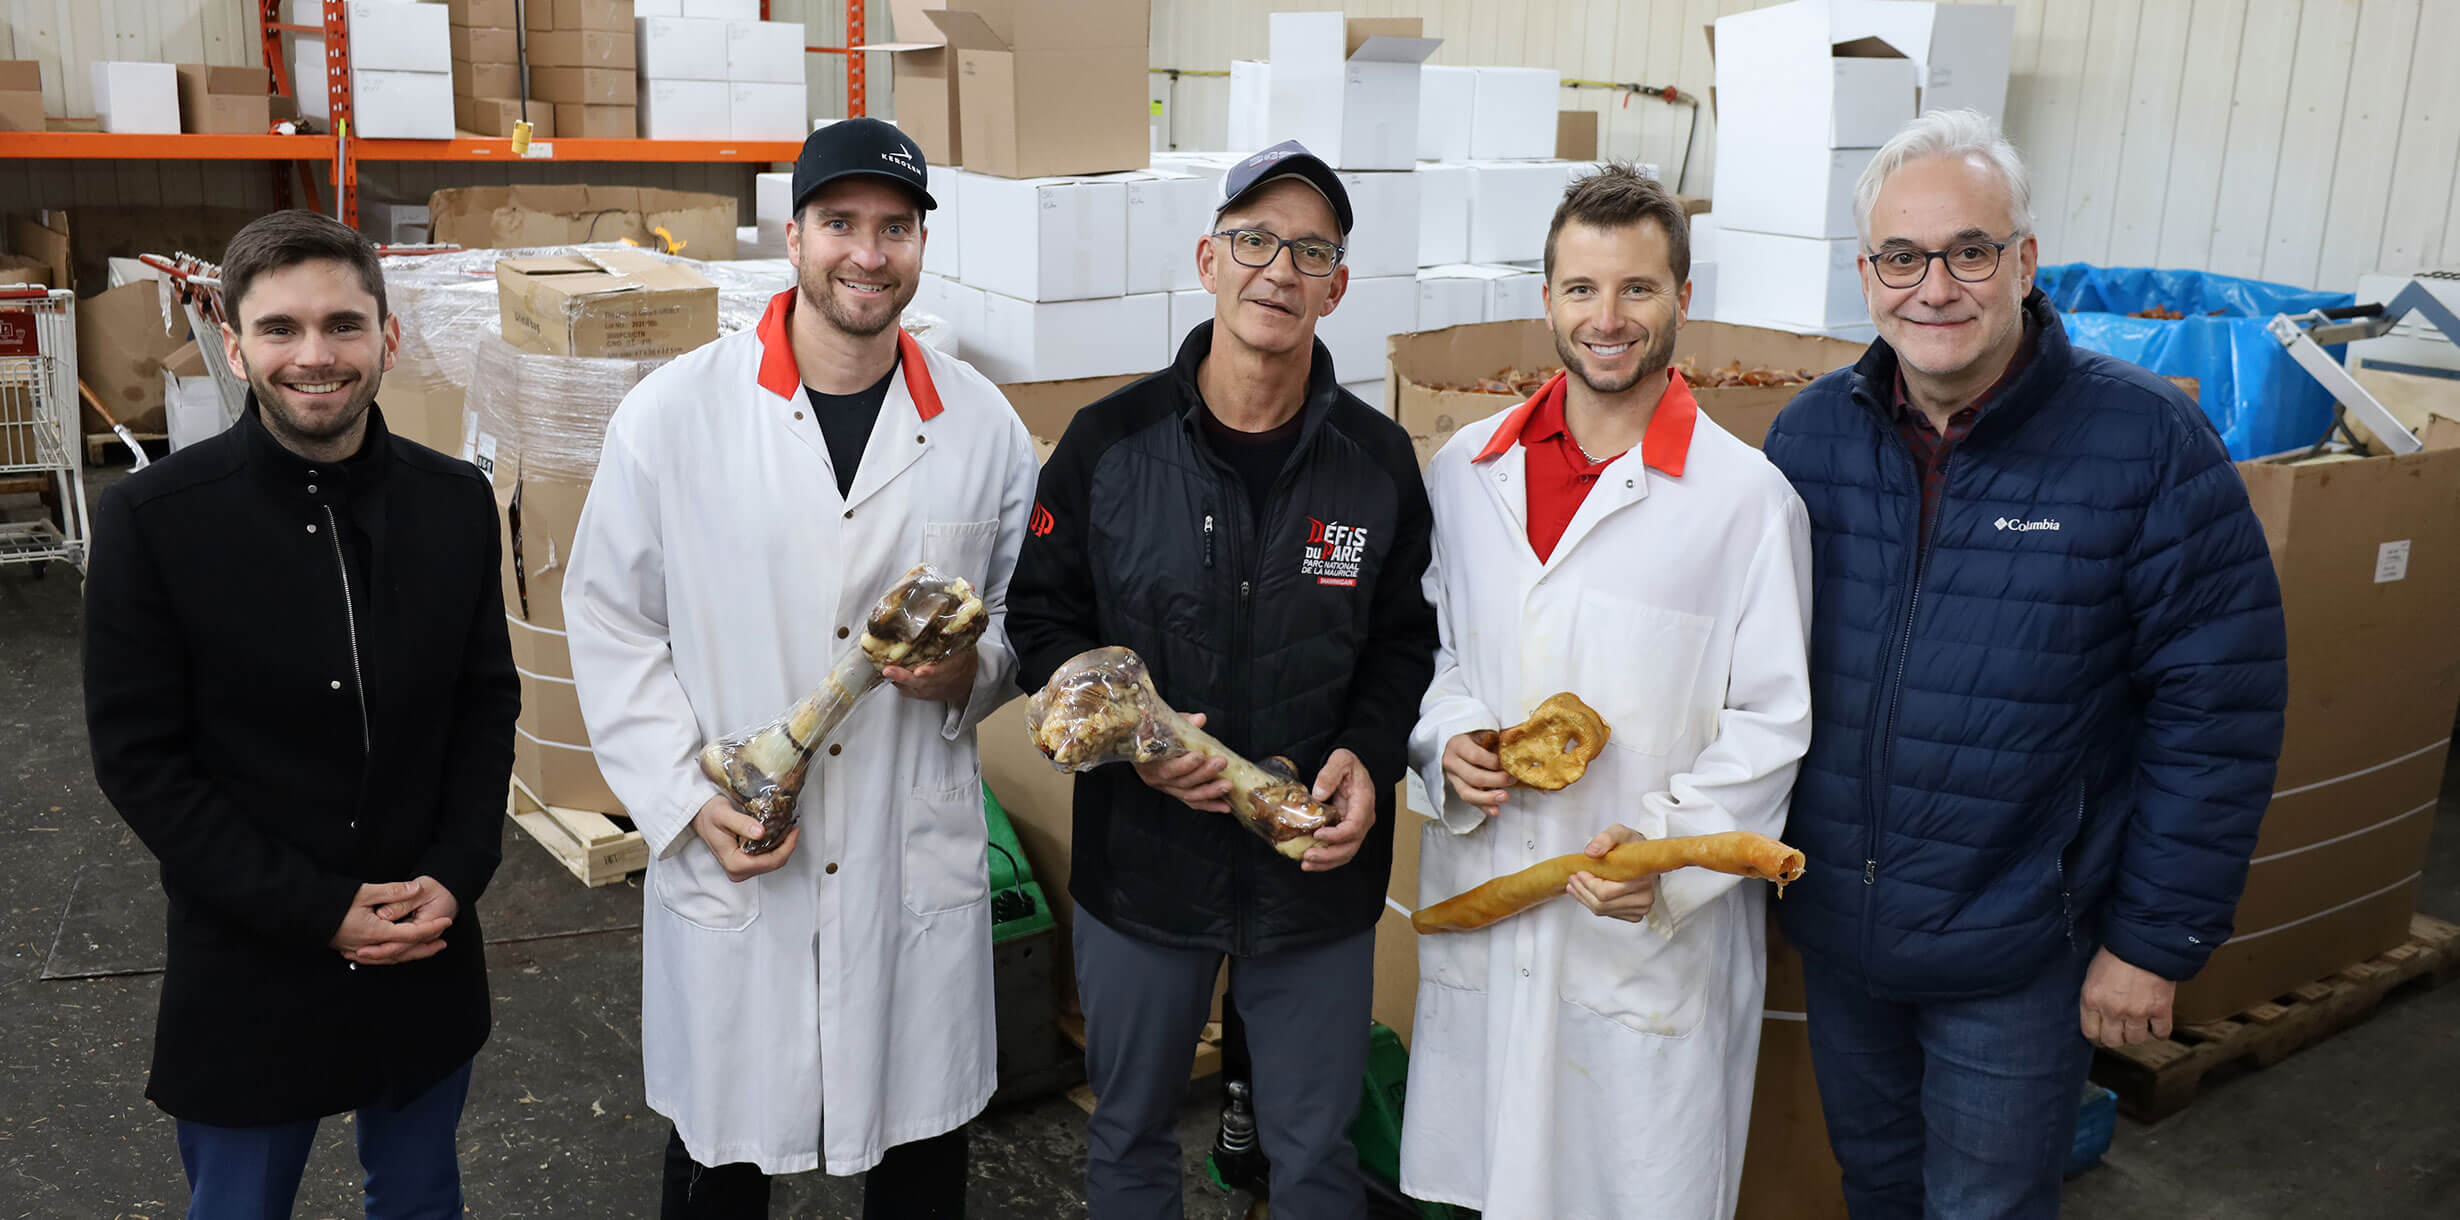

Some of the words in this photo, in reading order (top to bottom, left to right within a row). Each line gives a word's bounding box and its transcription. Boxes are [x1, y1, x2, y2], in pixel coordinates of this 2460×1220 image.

[2008, 518, 2060, 532] Columbia
[1305, 546, 1321, 559] DU
[1321, 540, 1363, 562] PARC
[1301, 566, 1312, 574] DE
[1313, 567, 1323, 575] LA
[1324, 568, 1358, 577] MAURICIE
[1303, 559, 1324, 568] PARC
[1324, 561, 1360, 571] NATIONAL
